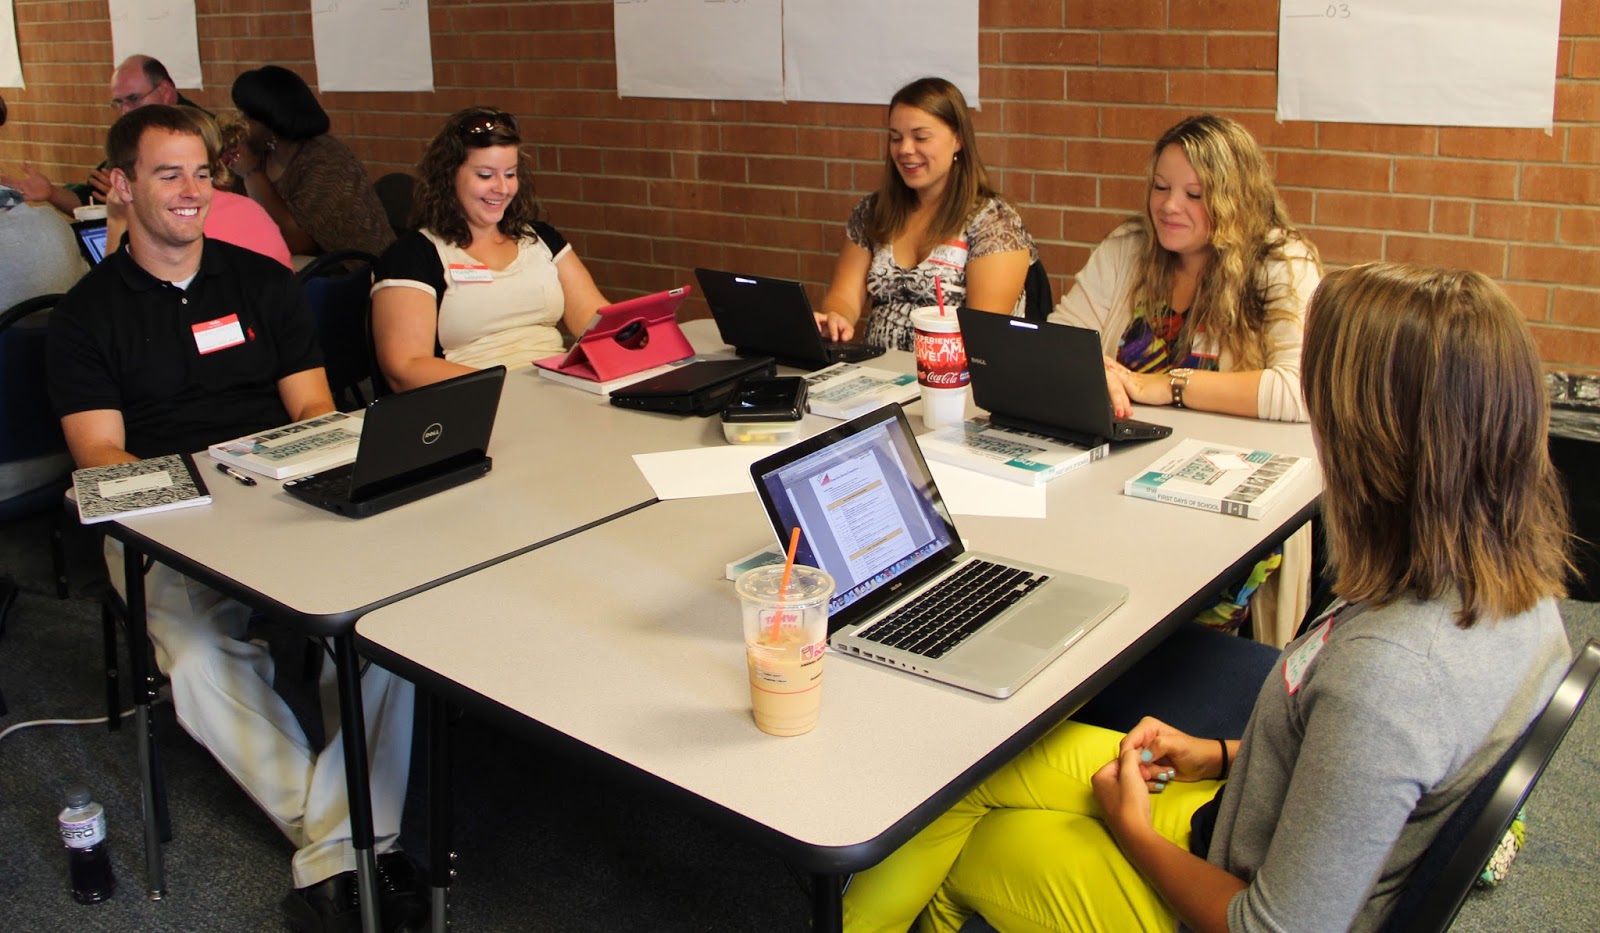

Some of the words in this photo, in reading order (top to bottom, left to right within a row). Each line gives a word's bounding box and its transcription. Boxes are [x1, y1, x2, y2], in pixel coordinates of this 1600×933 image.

[946, 352, 959, 362] IN
[1157, 493, 1173, 502] FIRST
[1173, 496, 1188, 505] DAYS
[1188, 499, 1198, 507] OF
[1197, 502, 1220, 512] SCHOOL
